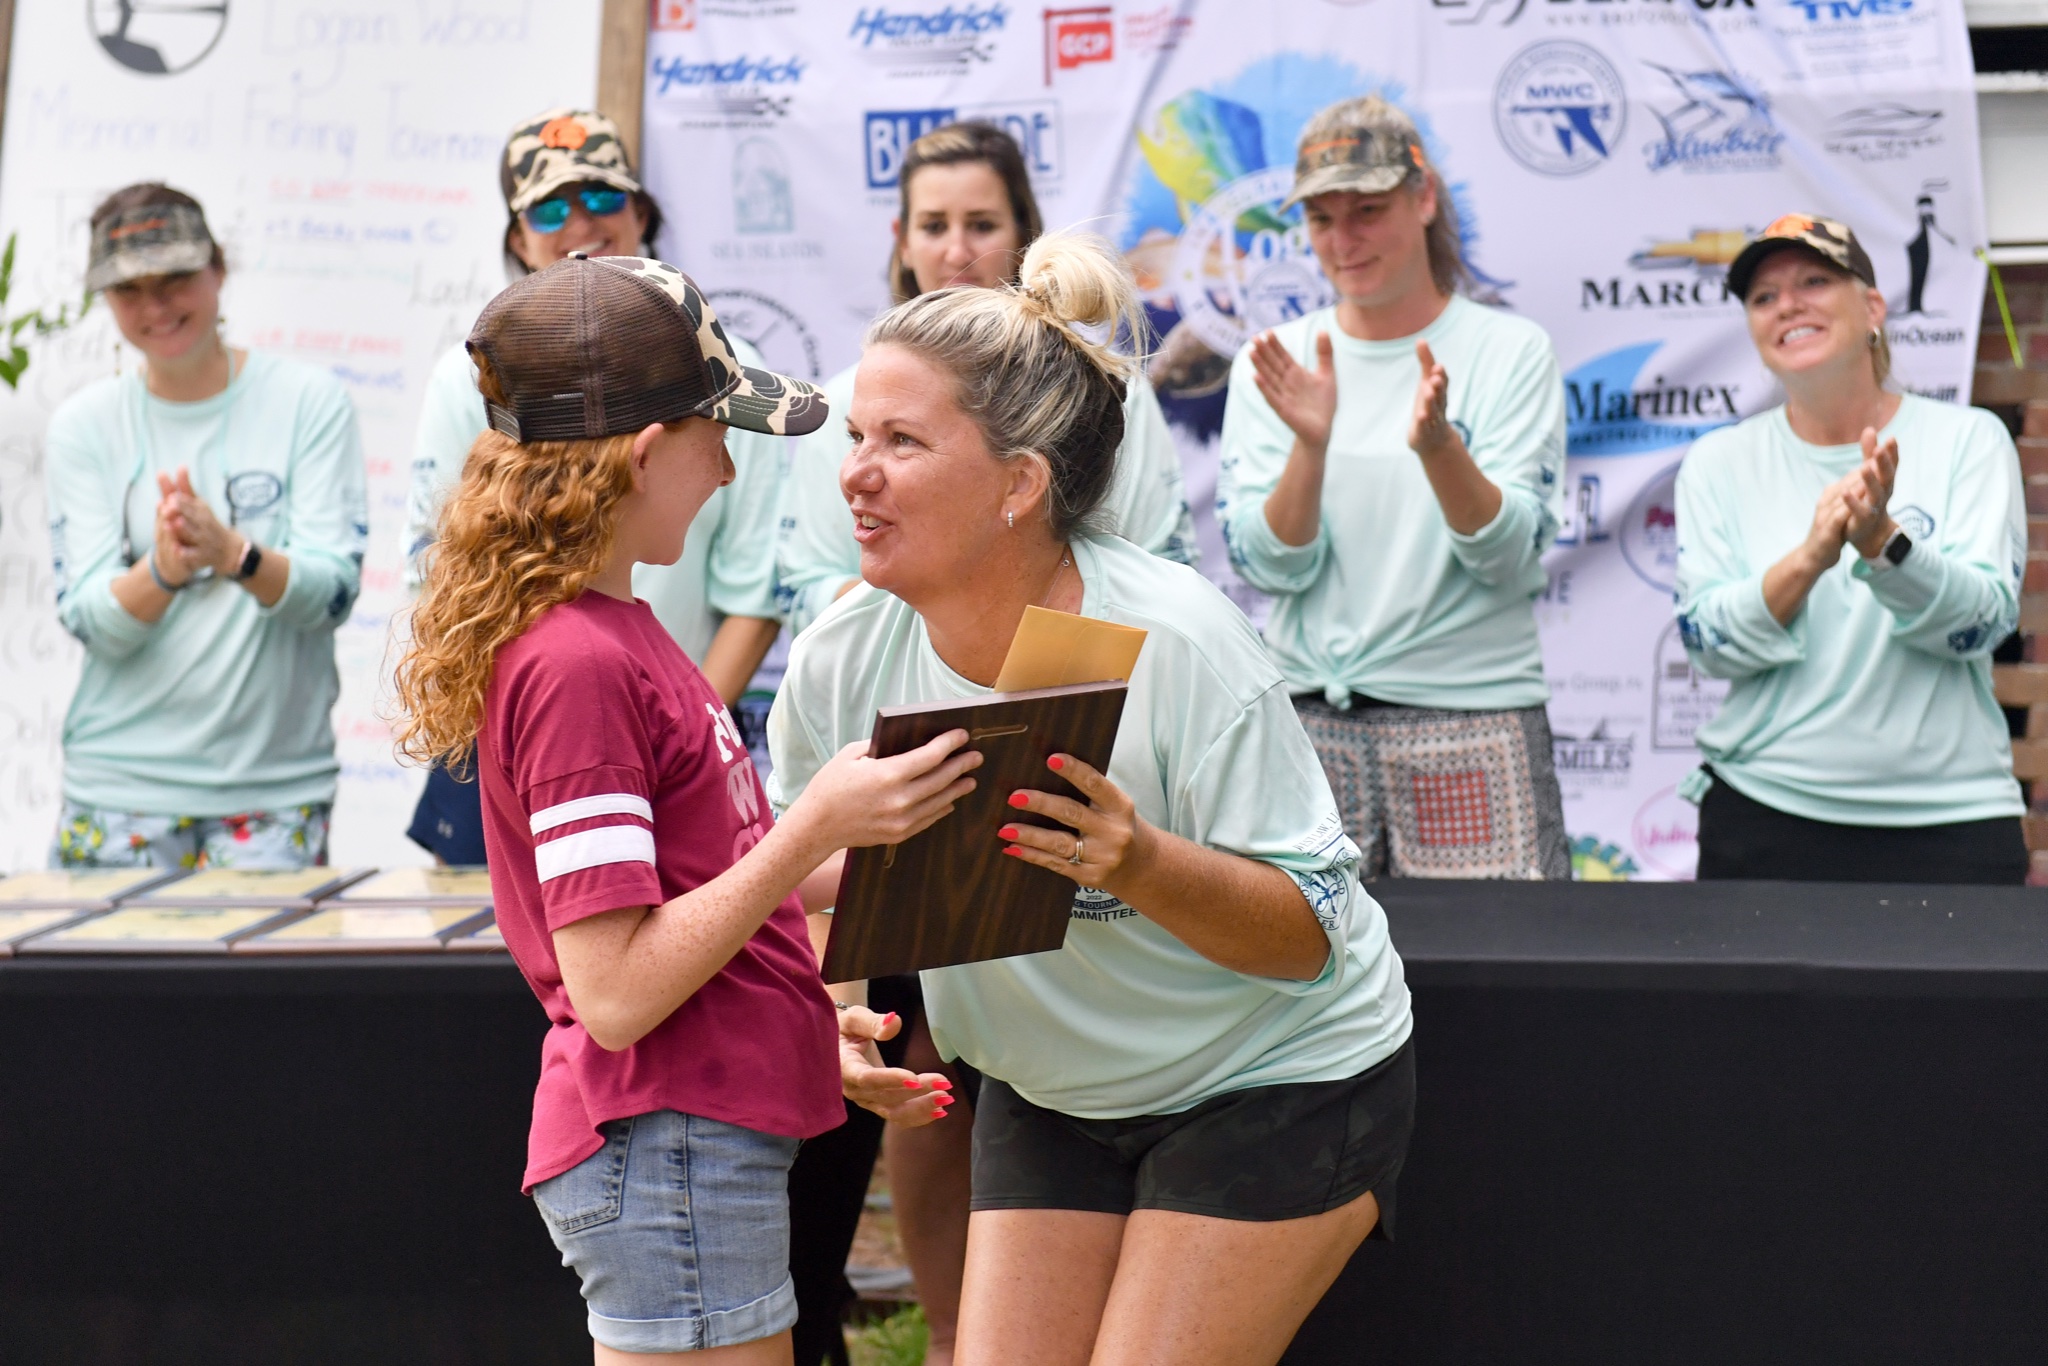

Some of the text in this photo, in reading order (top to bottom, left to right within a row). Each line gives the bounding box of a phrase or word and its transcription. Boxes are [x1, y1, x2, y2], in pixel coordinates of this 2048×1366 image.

[849, 4, 1009, 47] Hendrick
[652, 53, 808, 96] Hendrick
[1527, 83, 1594, 99] MWC
[1568, 374, 1742, 426] Marinex
[1069, 907, 1138, 922] MMITTEE
[1083, 899, 1119, 909] TOURNA
